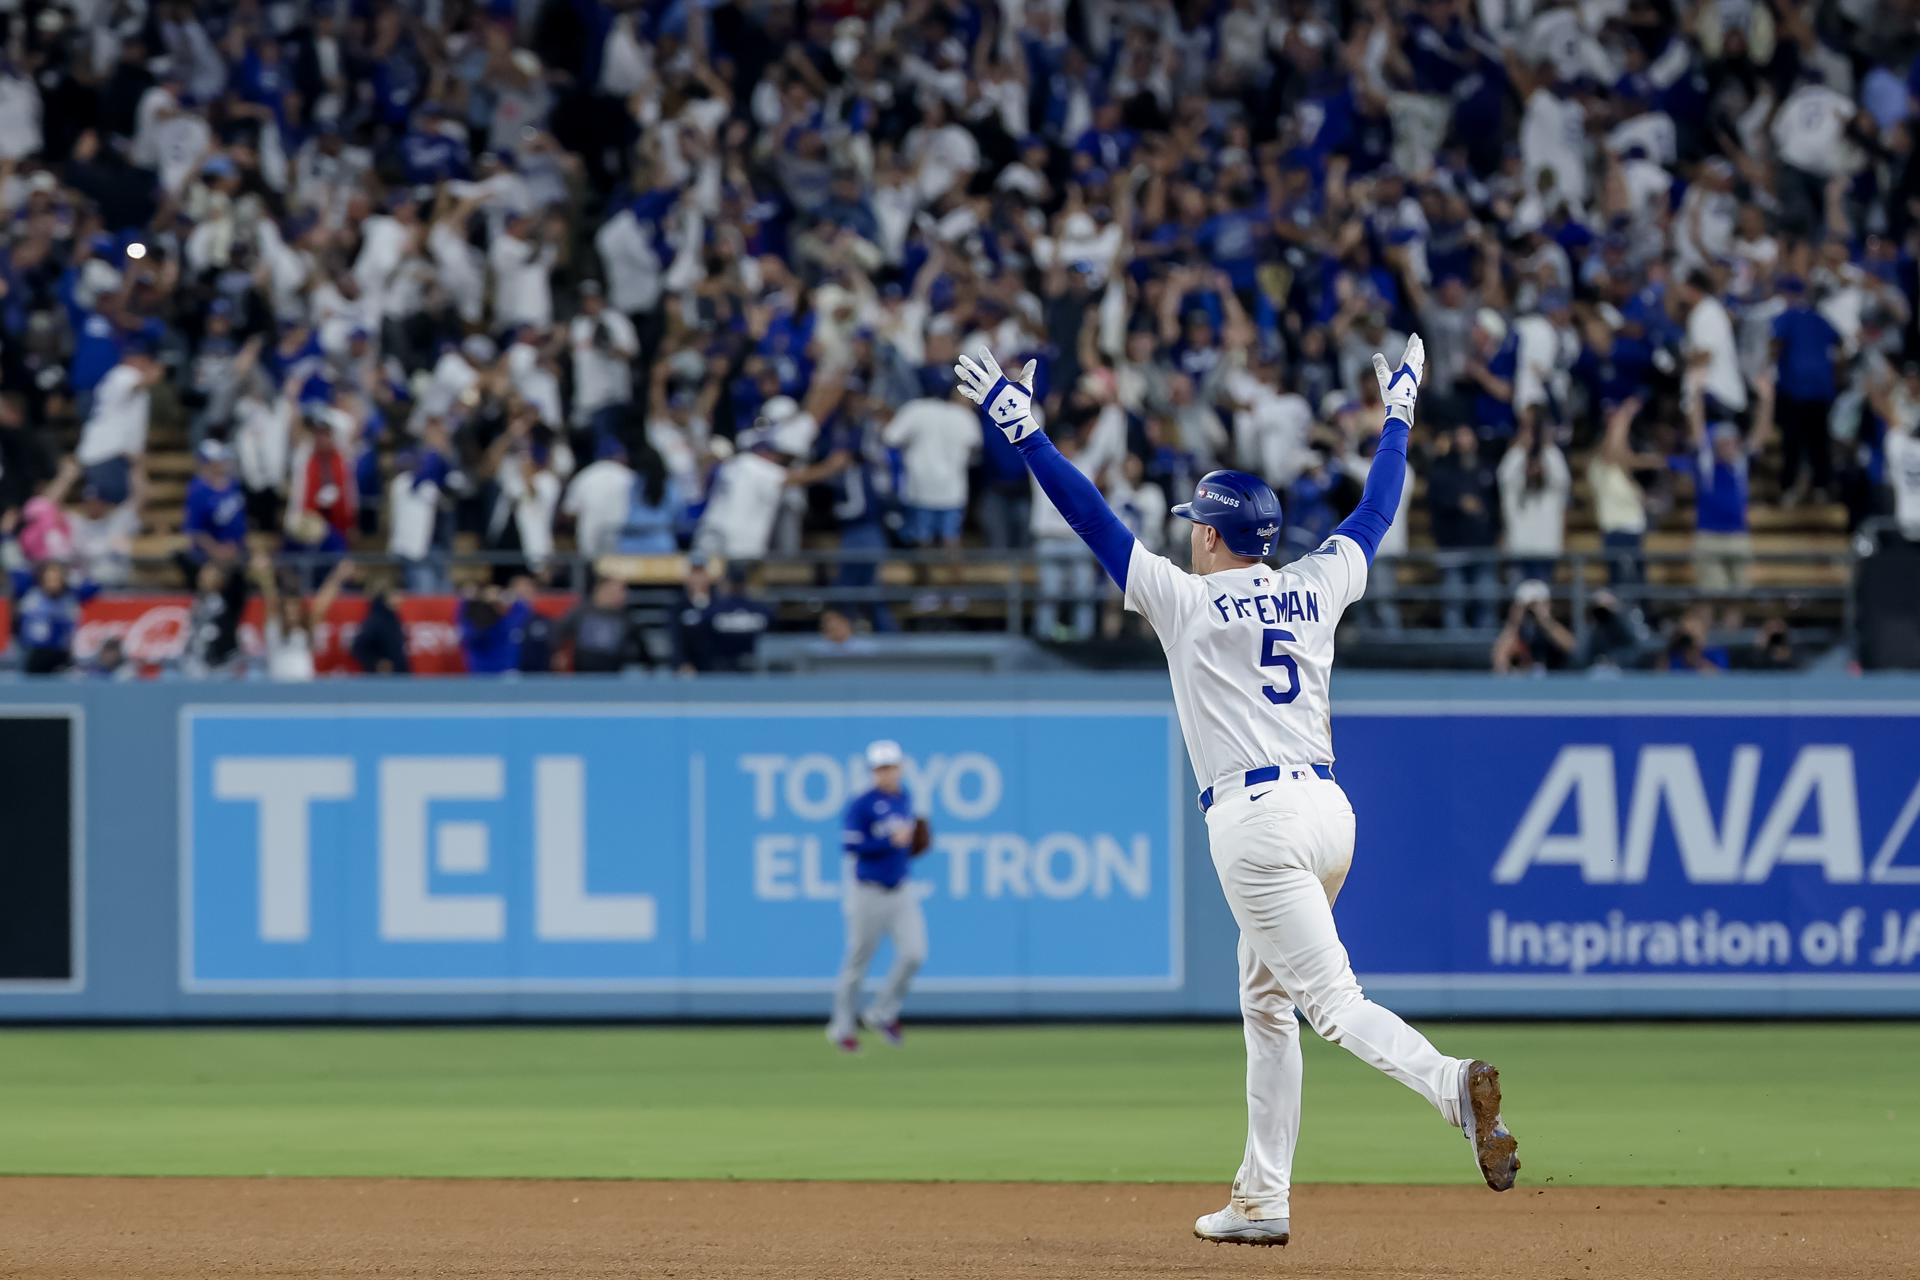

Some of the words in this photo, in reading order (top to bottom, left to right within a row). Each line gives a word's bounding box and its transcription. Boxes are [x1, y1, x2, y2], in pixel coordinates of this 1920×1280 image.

[1206, 491, 1240, 508] STRAUSS
[1262, 543, 1271, 556] 5
[1260, 628, 1302, 705] 5
[1493, 745, 1864, 884] ANA
[213, 756, 657, 942] TEL
[755, 834, 1150, 899] ELTRON
[1489, 910, 1790, 972] Inspiration
[1800, 908, 1864, 964] of
